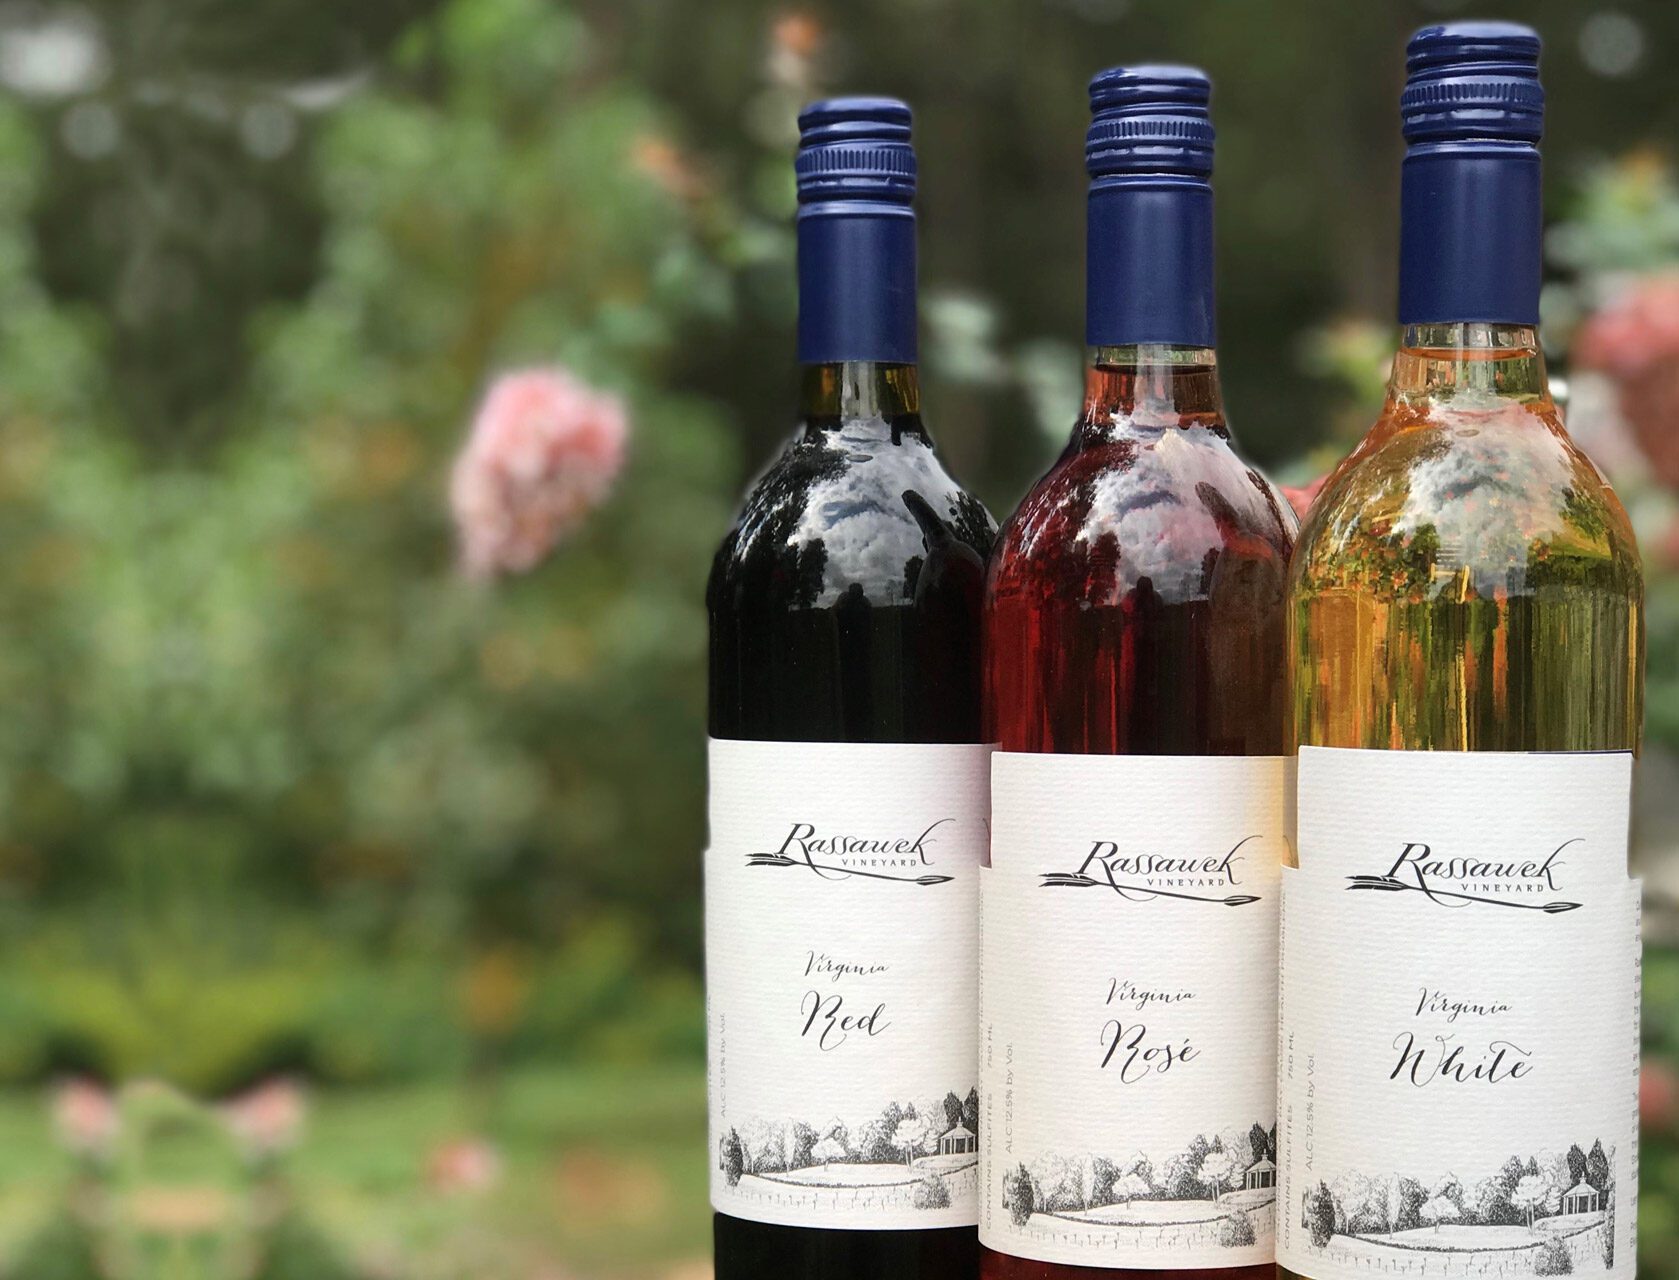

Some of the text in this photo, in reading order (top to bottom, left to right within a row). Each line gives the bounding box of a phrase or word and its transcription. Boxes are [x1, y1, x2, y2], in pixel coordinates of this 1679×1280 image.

[775, 818, 956, 881] Rassawek
[841, 858, 918, 868] VINEYARD
[1075, 835, 1263, 902] Rassawek
[1146, 878, 1225, 887] VINEYARD
[1384, 838, 1586, 908] Rassawek
[1460, 883, 1545, 893] VINEYARD
[804, 950, 889, 983] Virginia
[1105, 977, 1197, 1011] Virginia
[1415, 986, 1513, 1023] Virginia
[801, 990, 892, 1051] Red
[1100, 1019, 1201, 1085] Rosé
[1389, 1031, 1535, 1088] White
[1005, 1068, 1014, 1086] by
[1306, 1080, 1316, 1099] by
[1005, 1088, 1013, 1123] 12.5%
[1305, 1102, 1314, 1138] 12.5%
[1005, 1126, 1013, 1155] ALC
[1305, 1141, 1313, 1171] ALC
